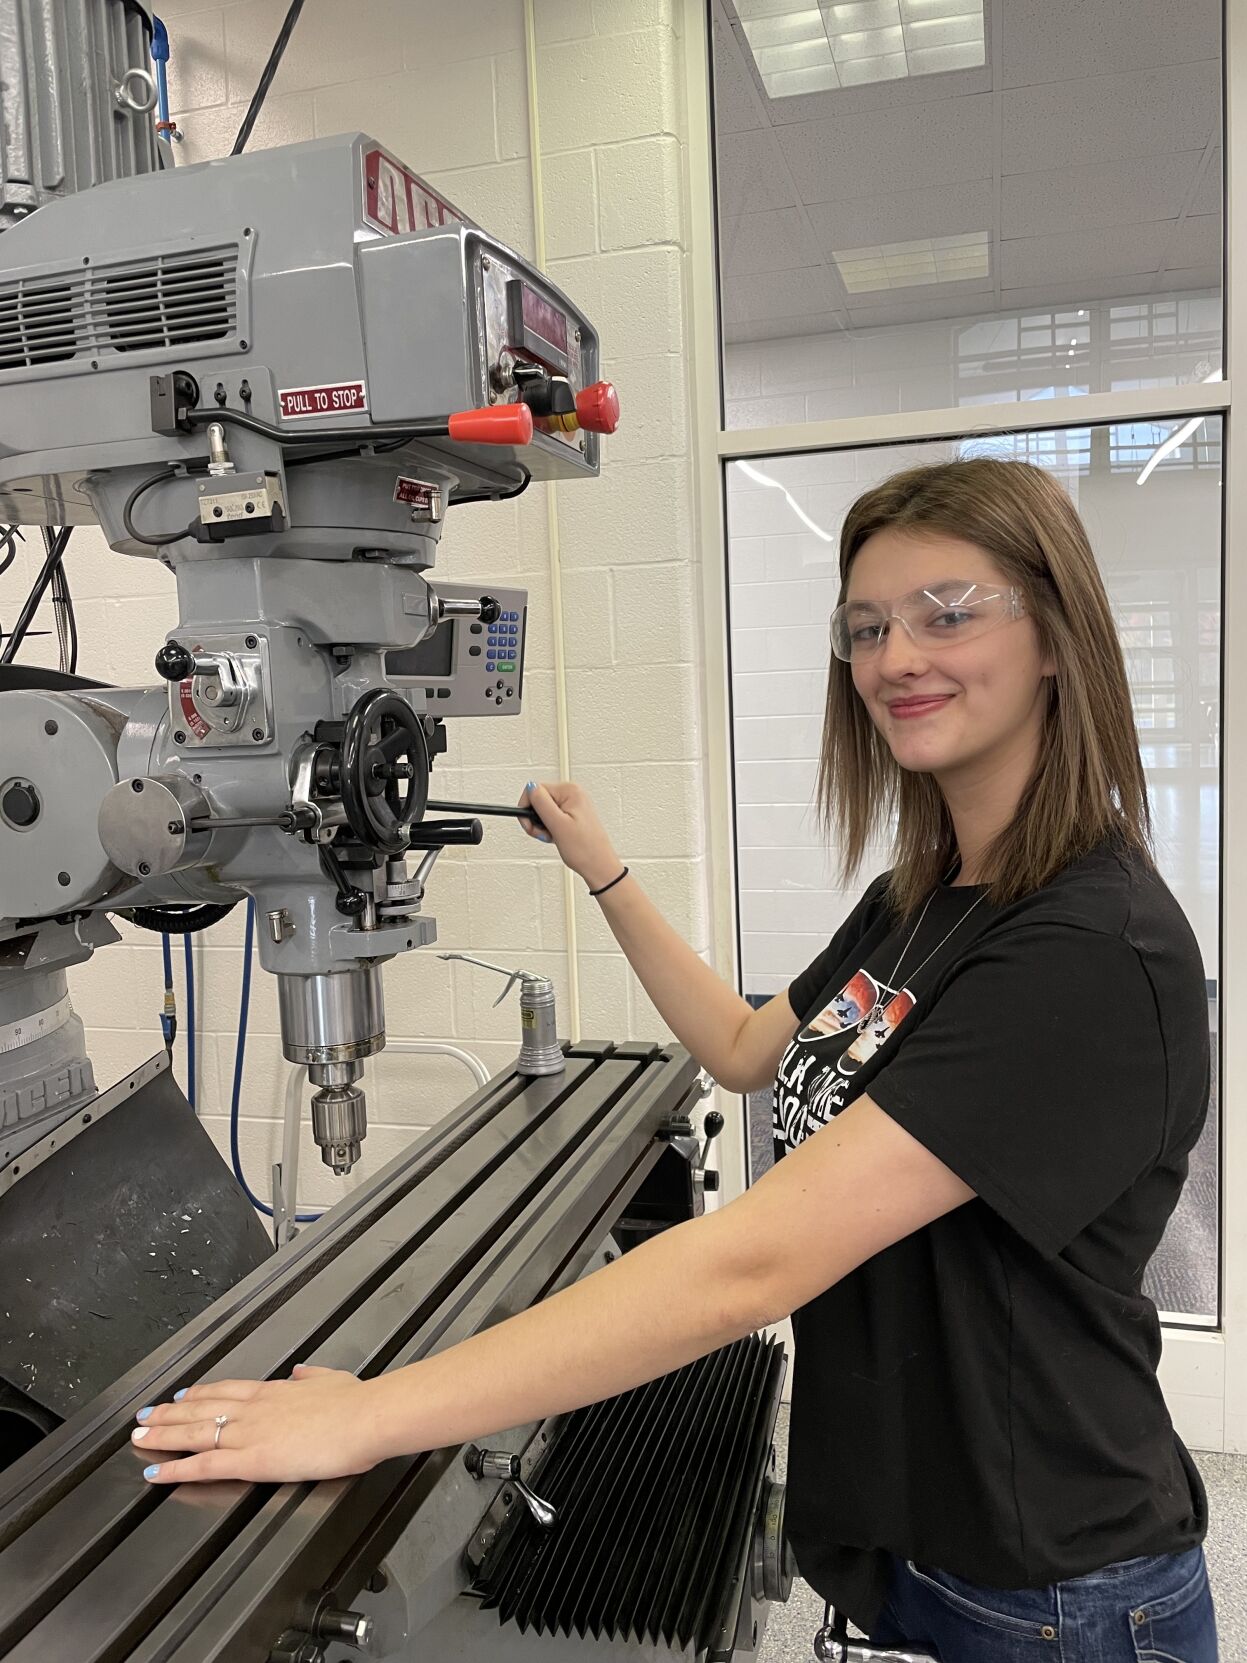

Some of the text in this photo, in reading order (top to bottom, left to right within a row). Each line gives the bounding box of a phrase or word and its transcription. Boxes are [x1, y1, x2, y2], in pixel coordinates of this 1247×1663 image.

[287, 389, 358, 412] PULL TO STOP
